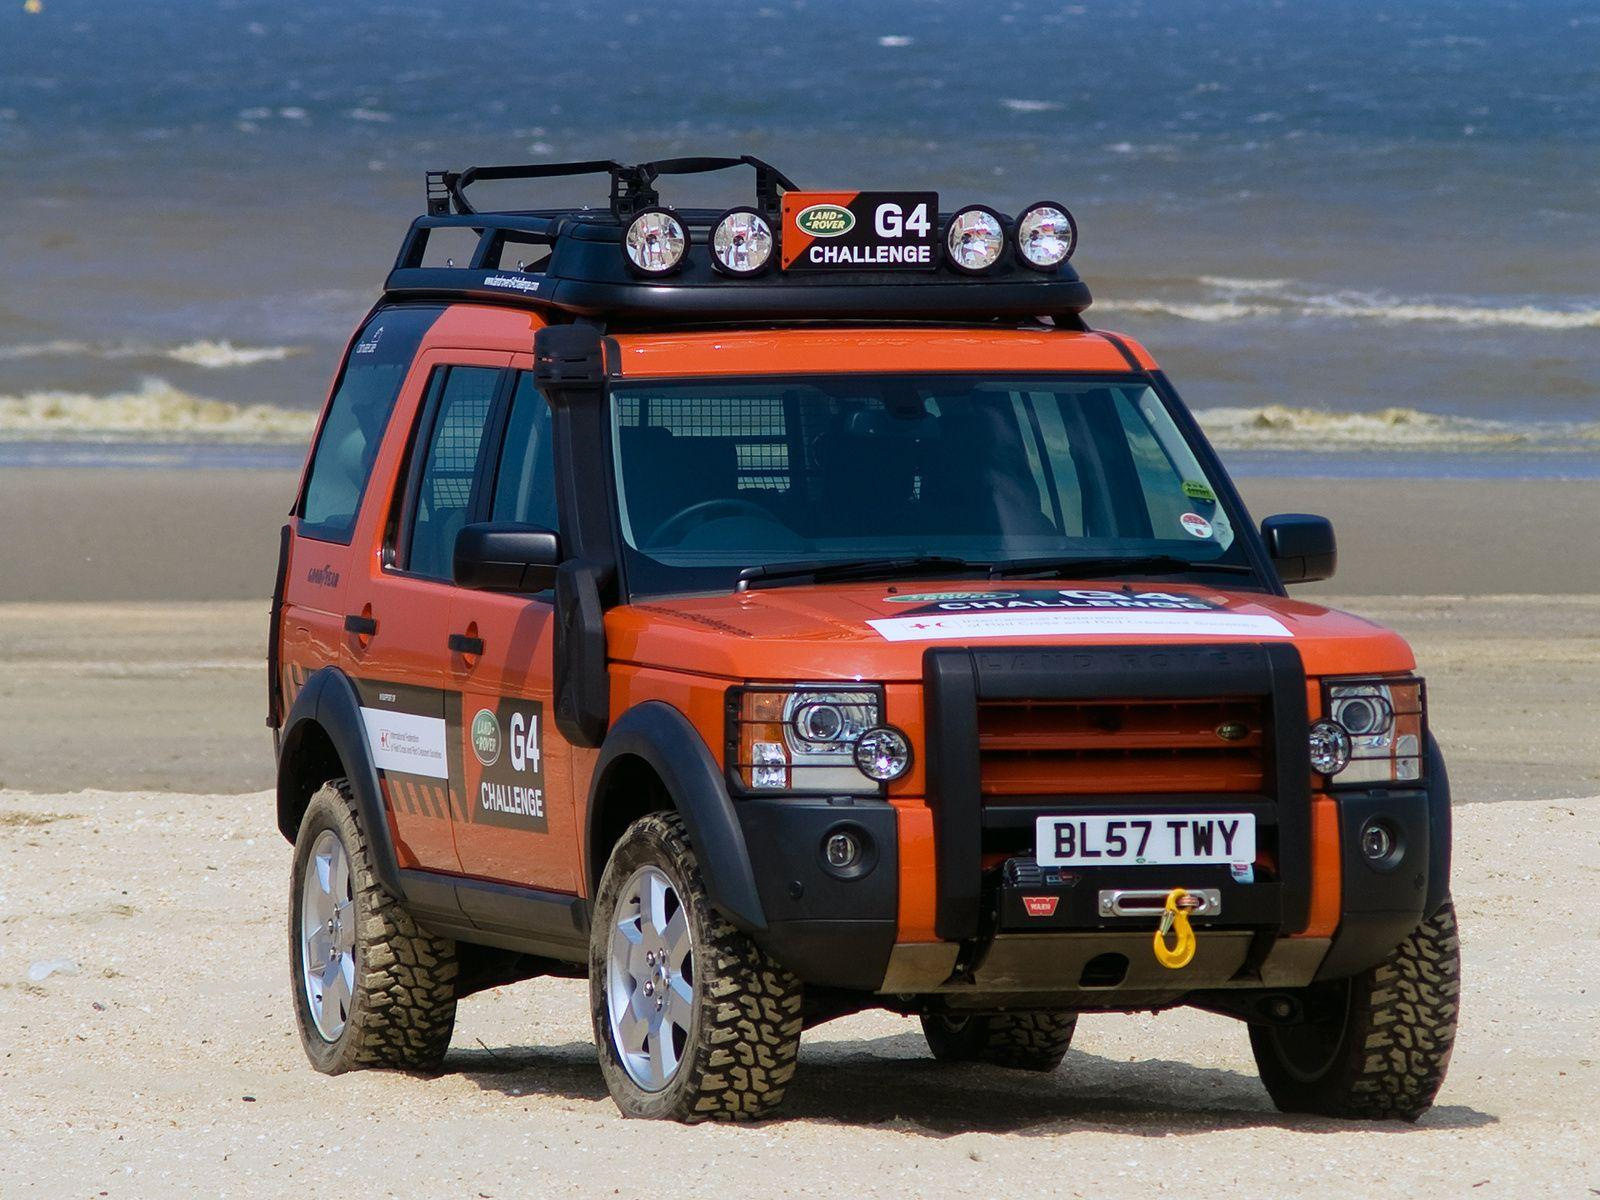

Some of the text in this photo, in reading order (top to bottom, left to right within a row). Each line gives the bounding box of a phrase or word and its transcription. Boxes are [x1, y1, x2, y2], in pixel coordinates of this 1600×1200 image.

[808, 211, 837, 220] LAND
[811, 220, 846, 230] ROVER
[874, 202, 932, 238] G4
[809, 245, 931, 264] CHALLENGE
[938, 600, 1211, 610] CHALLENGE
[1058, 590, 1190, 602] G4
[509, 711, 540, 773] G4
[481, 781, 544, 818] CHALLENGE
[1054, 820, 1240, 859] BL57 TWY
